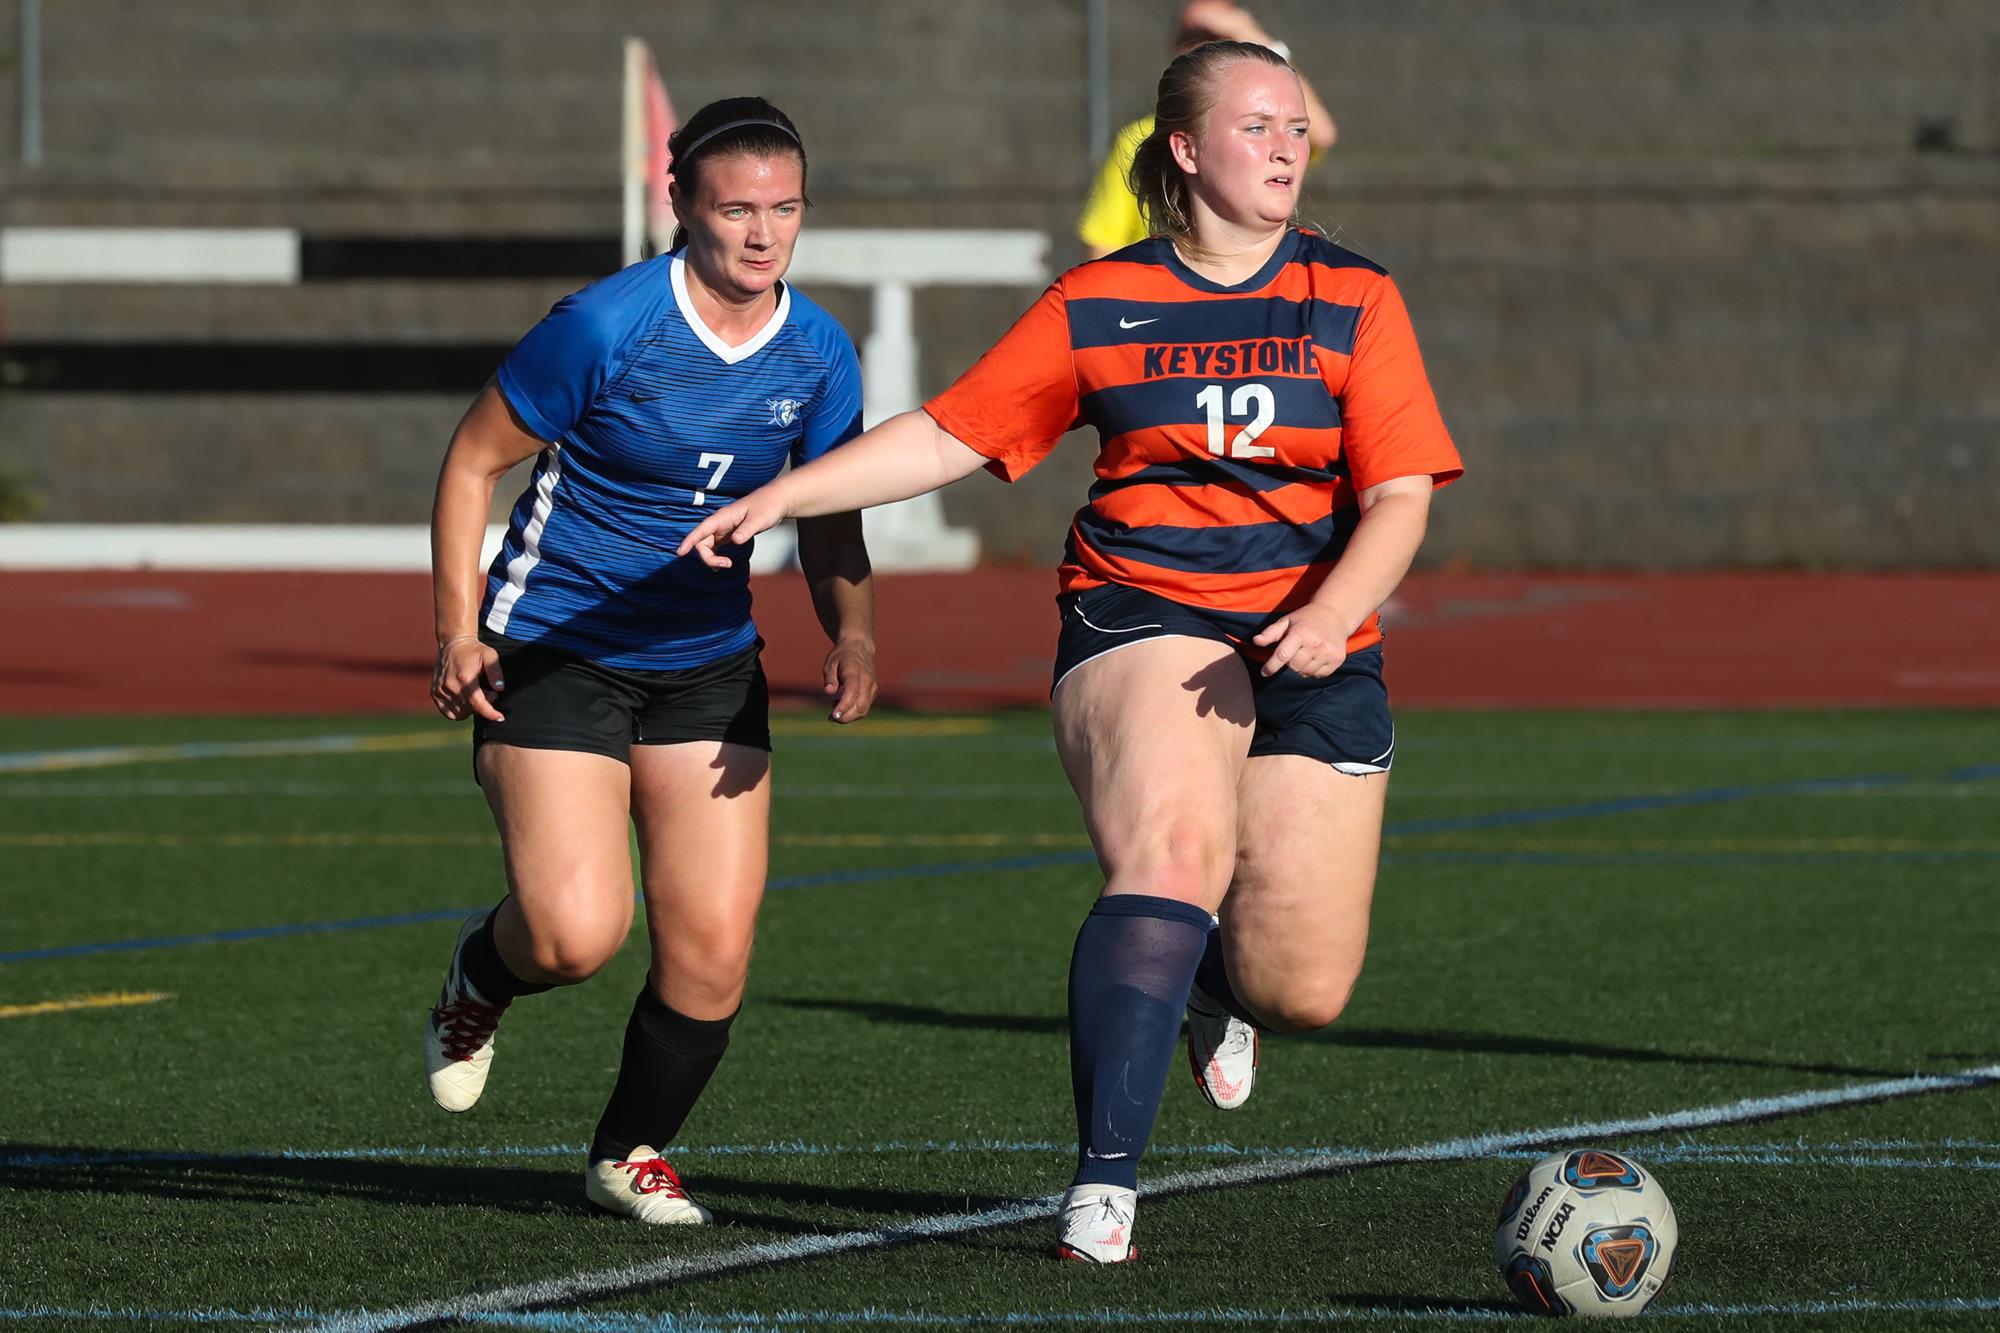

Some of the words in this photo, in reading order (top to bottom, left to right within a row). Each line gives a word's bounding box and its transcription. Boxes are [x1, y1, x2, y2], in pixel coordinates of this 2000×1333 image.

[1144, 338, 1319, 378] KEYSTONE
[1196, 383, 1275, 458] 12
[692, 452, 735, 506] 7
[1516, 1186, 1555, 1241] Wilson
[1541, 1202, 1577, 1253] NCAA
